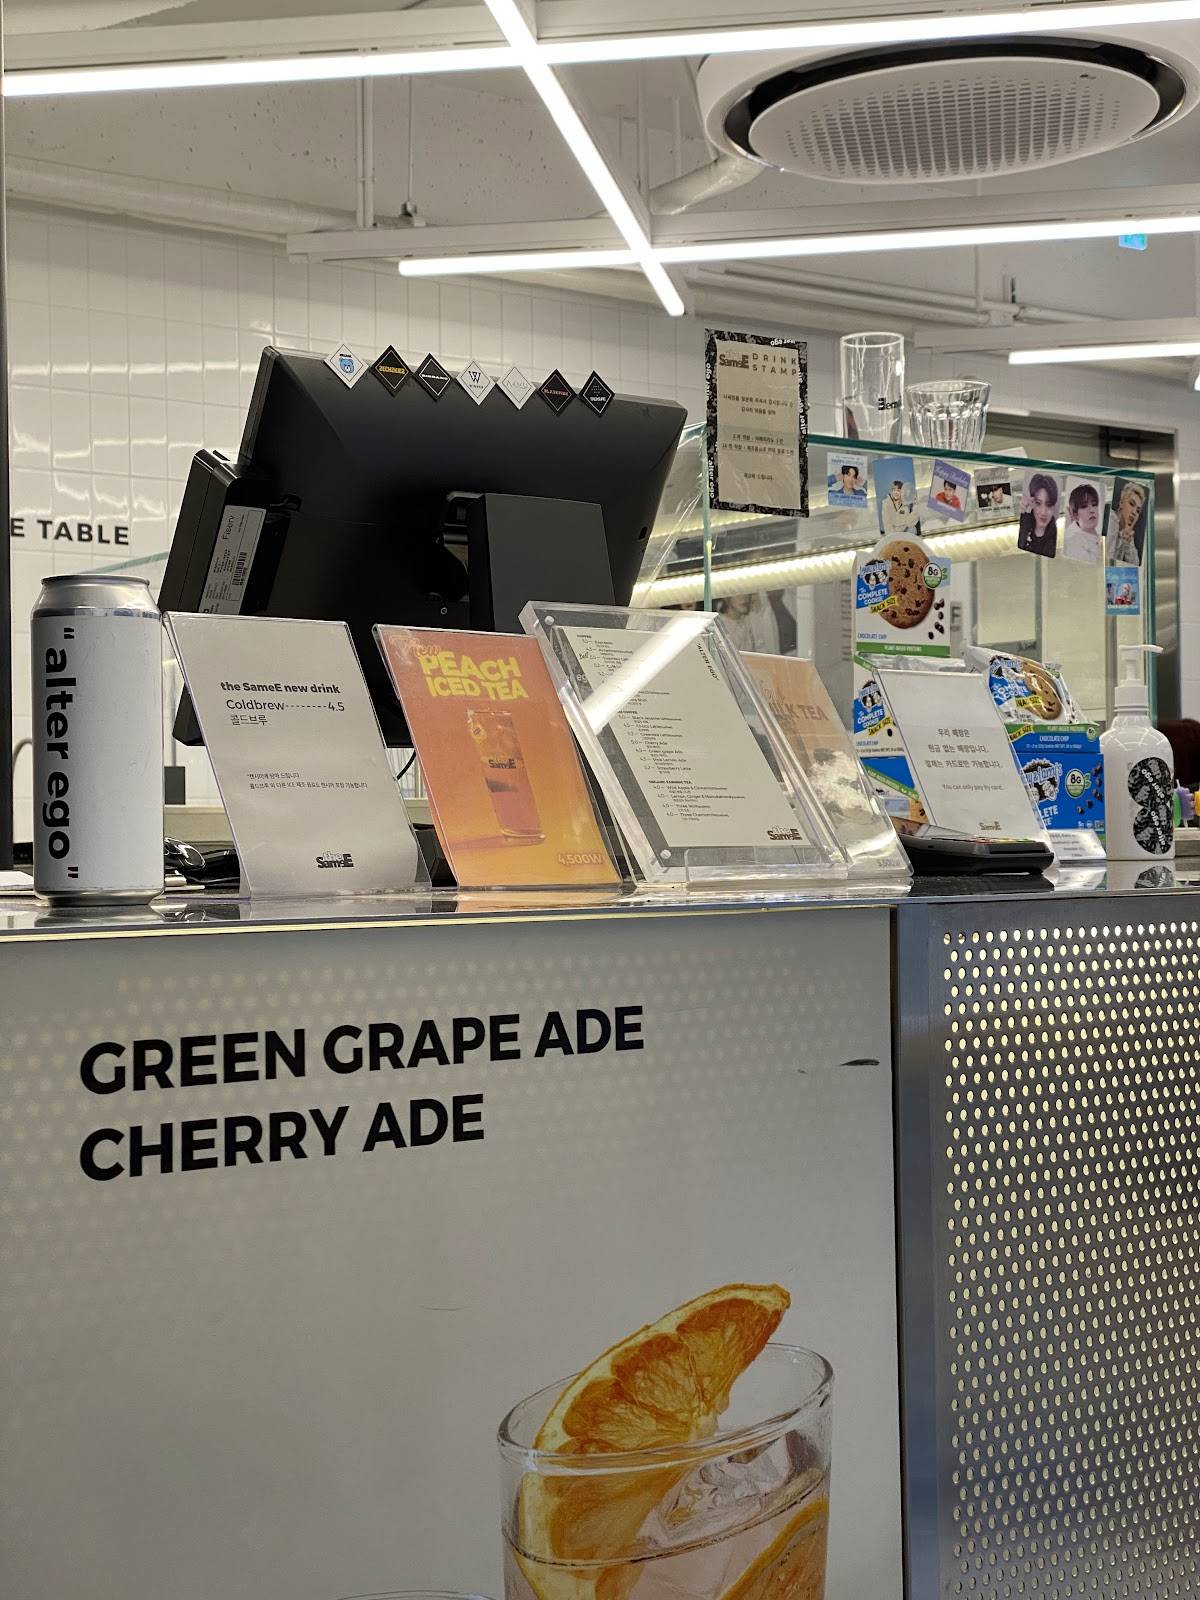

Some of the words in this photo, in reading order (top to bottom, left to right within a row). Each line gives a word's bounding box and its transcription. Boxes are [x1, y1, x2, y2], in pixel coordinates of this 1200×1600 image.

[752, 353, 796, 365] DRINK
[752, 364, 797, 376] STAMP
[37, 519, 130, 546] TABLE
[417, 650, 522, 683] PEACH
[220, 681, 241, 691] the
[243, 682, 283, 692] SameE
[284, 684, 308, 693] new
[310, 683, 341, 694] drink
[425, 676, 481, 698] ICED
[481, 679, 529, 701] TEA
[230, 714, 268, 726] 콜드브루
[1070, 773, 1082, 784] 8G
[767, 829, 802, 841] SameE
[315, 853, 354, 868] SameE
[80, 1028, 306, 1095] GREEN
[322, 1013, 521, 1075] GRAPE
[533, 1005, 645, 1058] ADE
[80, 1105, 350, 1181] CHERRY
[362, 1094, 486, 1153] ADE
